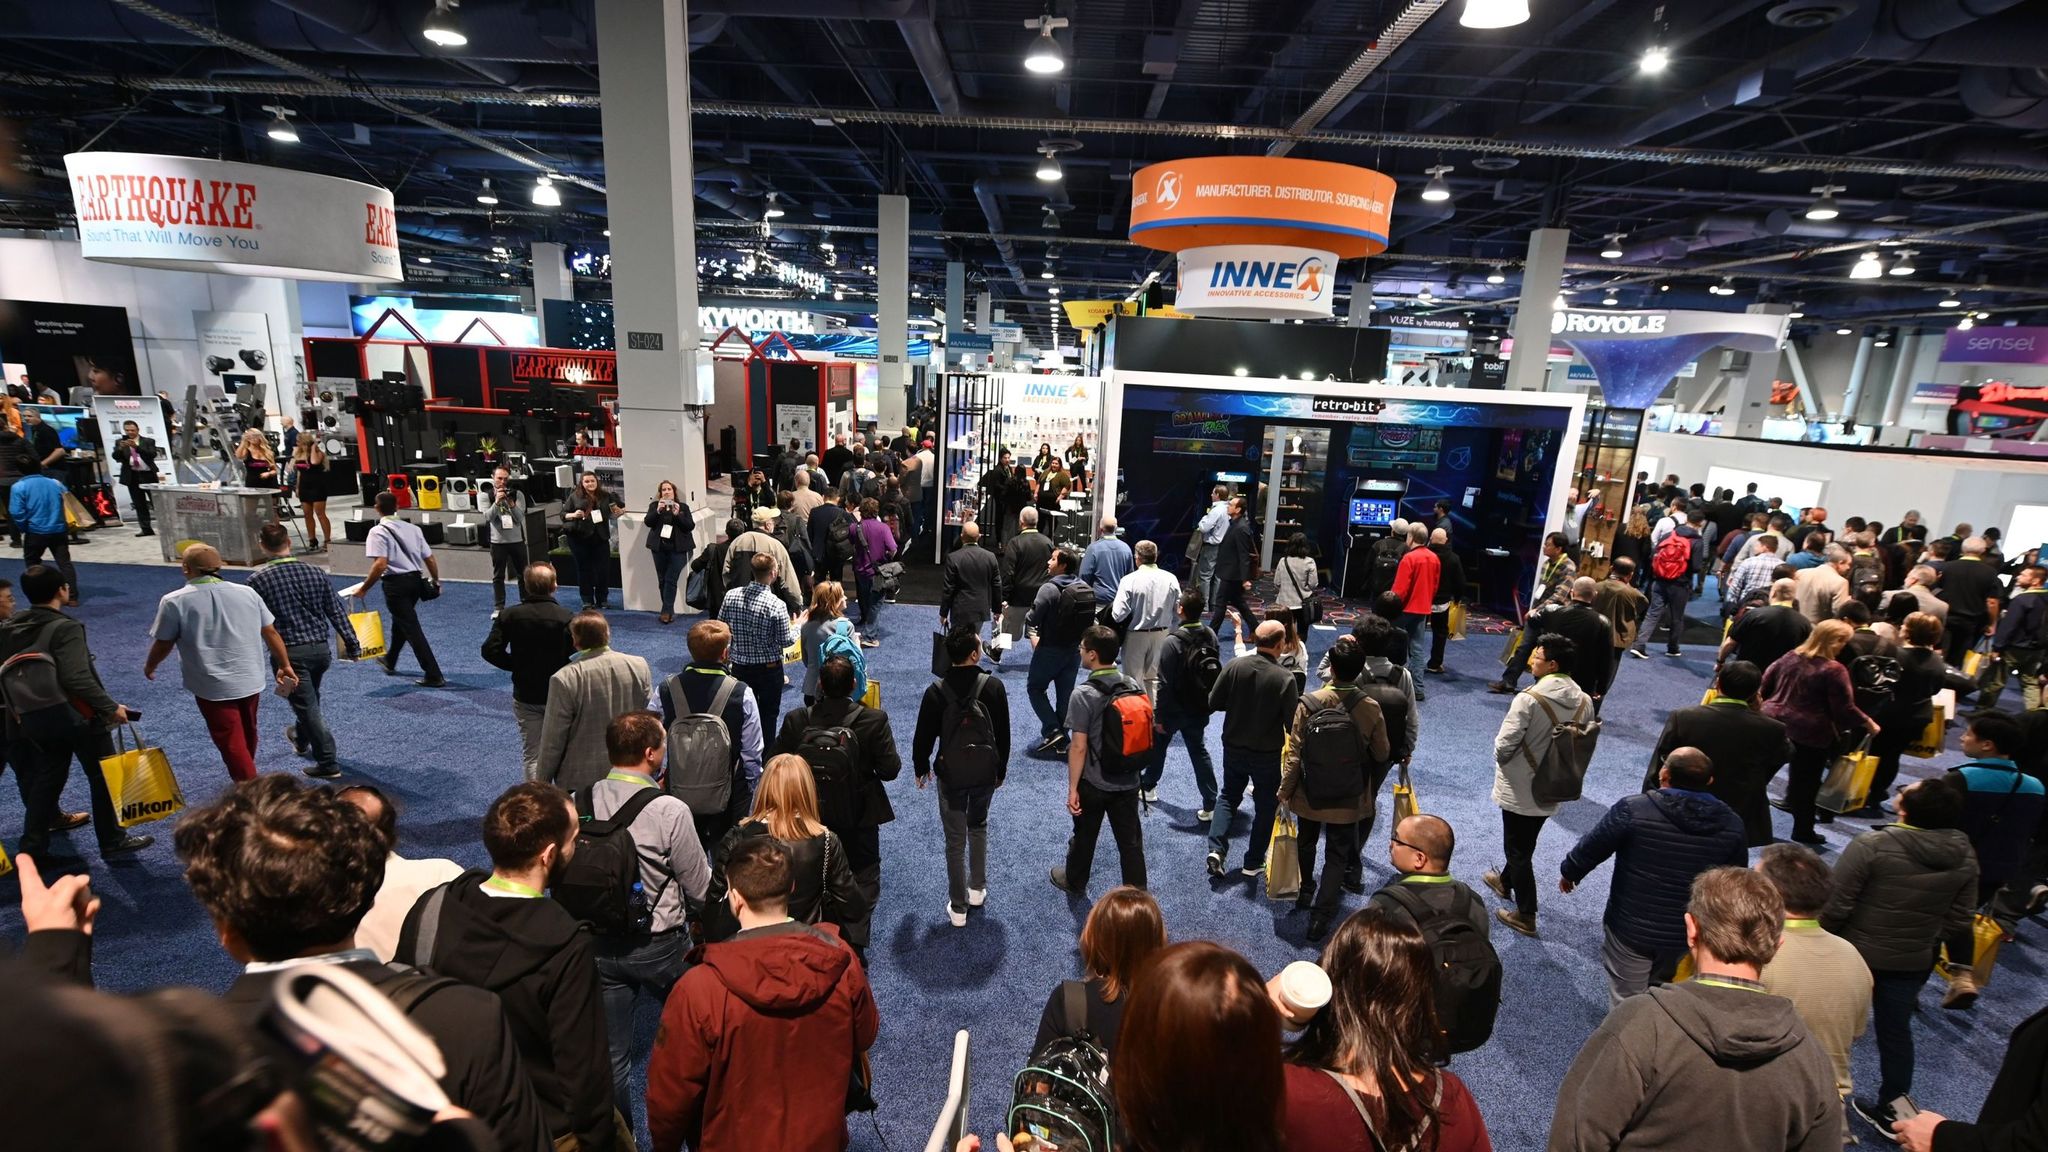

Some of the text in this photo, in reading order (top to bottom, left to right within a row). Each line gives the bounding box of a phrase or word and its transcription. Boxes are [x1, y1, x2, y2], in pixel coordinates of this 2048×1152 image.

[77, 175, 256, 229] EARTHQUAKE
[1196, 184, 1273, 198] MANUFACTURER.
[1274, 186, 1335, 204] DISTRIBUTOR.
[1336, 192, 1371, 211] SOURCING
[87, 229, 259, 250] Sound That Will Move You
[1210, 260, 1324, 294] INNEX
[1254, 291, 1305, 299] ACCESSORIES
[698, 307, 809, 334] KYWORTH
[1390, 316, 1415, 325] VUZE
[1566, 313, 1666, 333] ROYOLE
[630, 333, 661, 349] S1-024
[1966, 336, 2036, 351] sensel
[515, 356, 616, 383] EARTHQUAKE
[1483, 361, 1505, 370] tobii
[359, 646, 384, 658] ikon
[121, 799, 173, 822] Nikon
